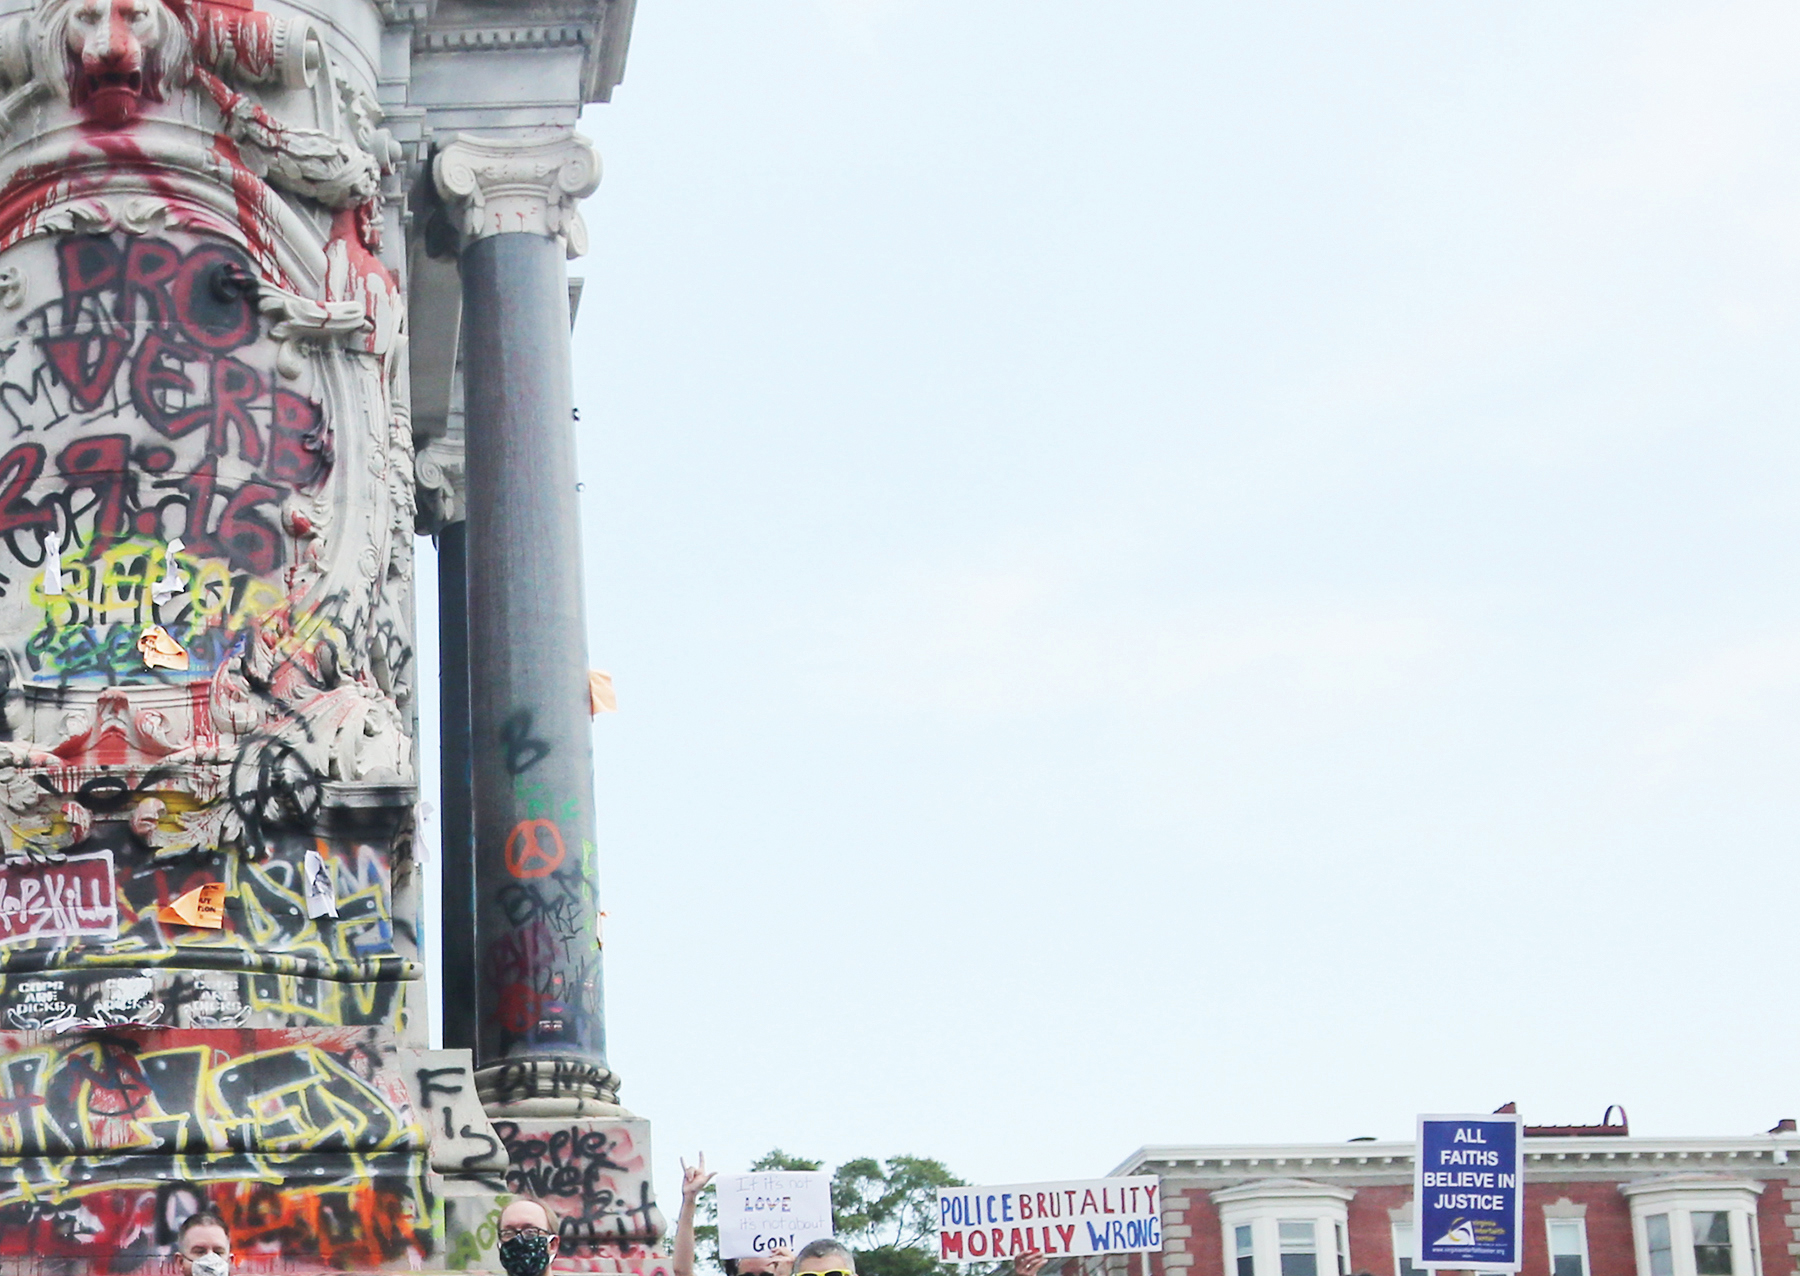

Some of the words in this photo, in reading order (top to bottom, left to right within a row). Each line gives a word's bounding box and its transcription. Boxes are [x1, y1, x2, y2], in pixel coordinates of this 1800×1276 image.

[56, 235, 260, 353] PRO
[1453, 1128, 1487, 1144] ALL
[1440, 1150, 1499, 1166] FAITHS
[1423, 1172, 1494, 1188] BELIEVE
[1498, 1173, 1515, 1189] IN
[744, 1197, 792, 1212] LOVE
[941, 1193, 1014, 1227] POLICE
[1018, 1184, 1158, 1221] BRUTALITY
[1433, 1194, 1504, 1210] JUSTICE
[940, 1223, 1076, 1260] MORALLY
[1086, 1216, 1162, 1254] WRONG
